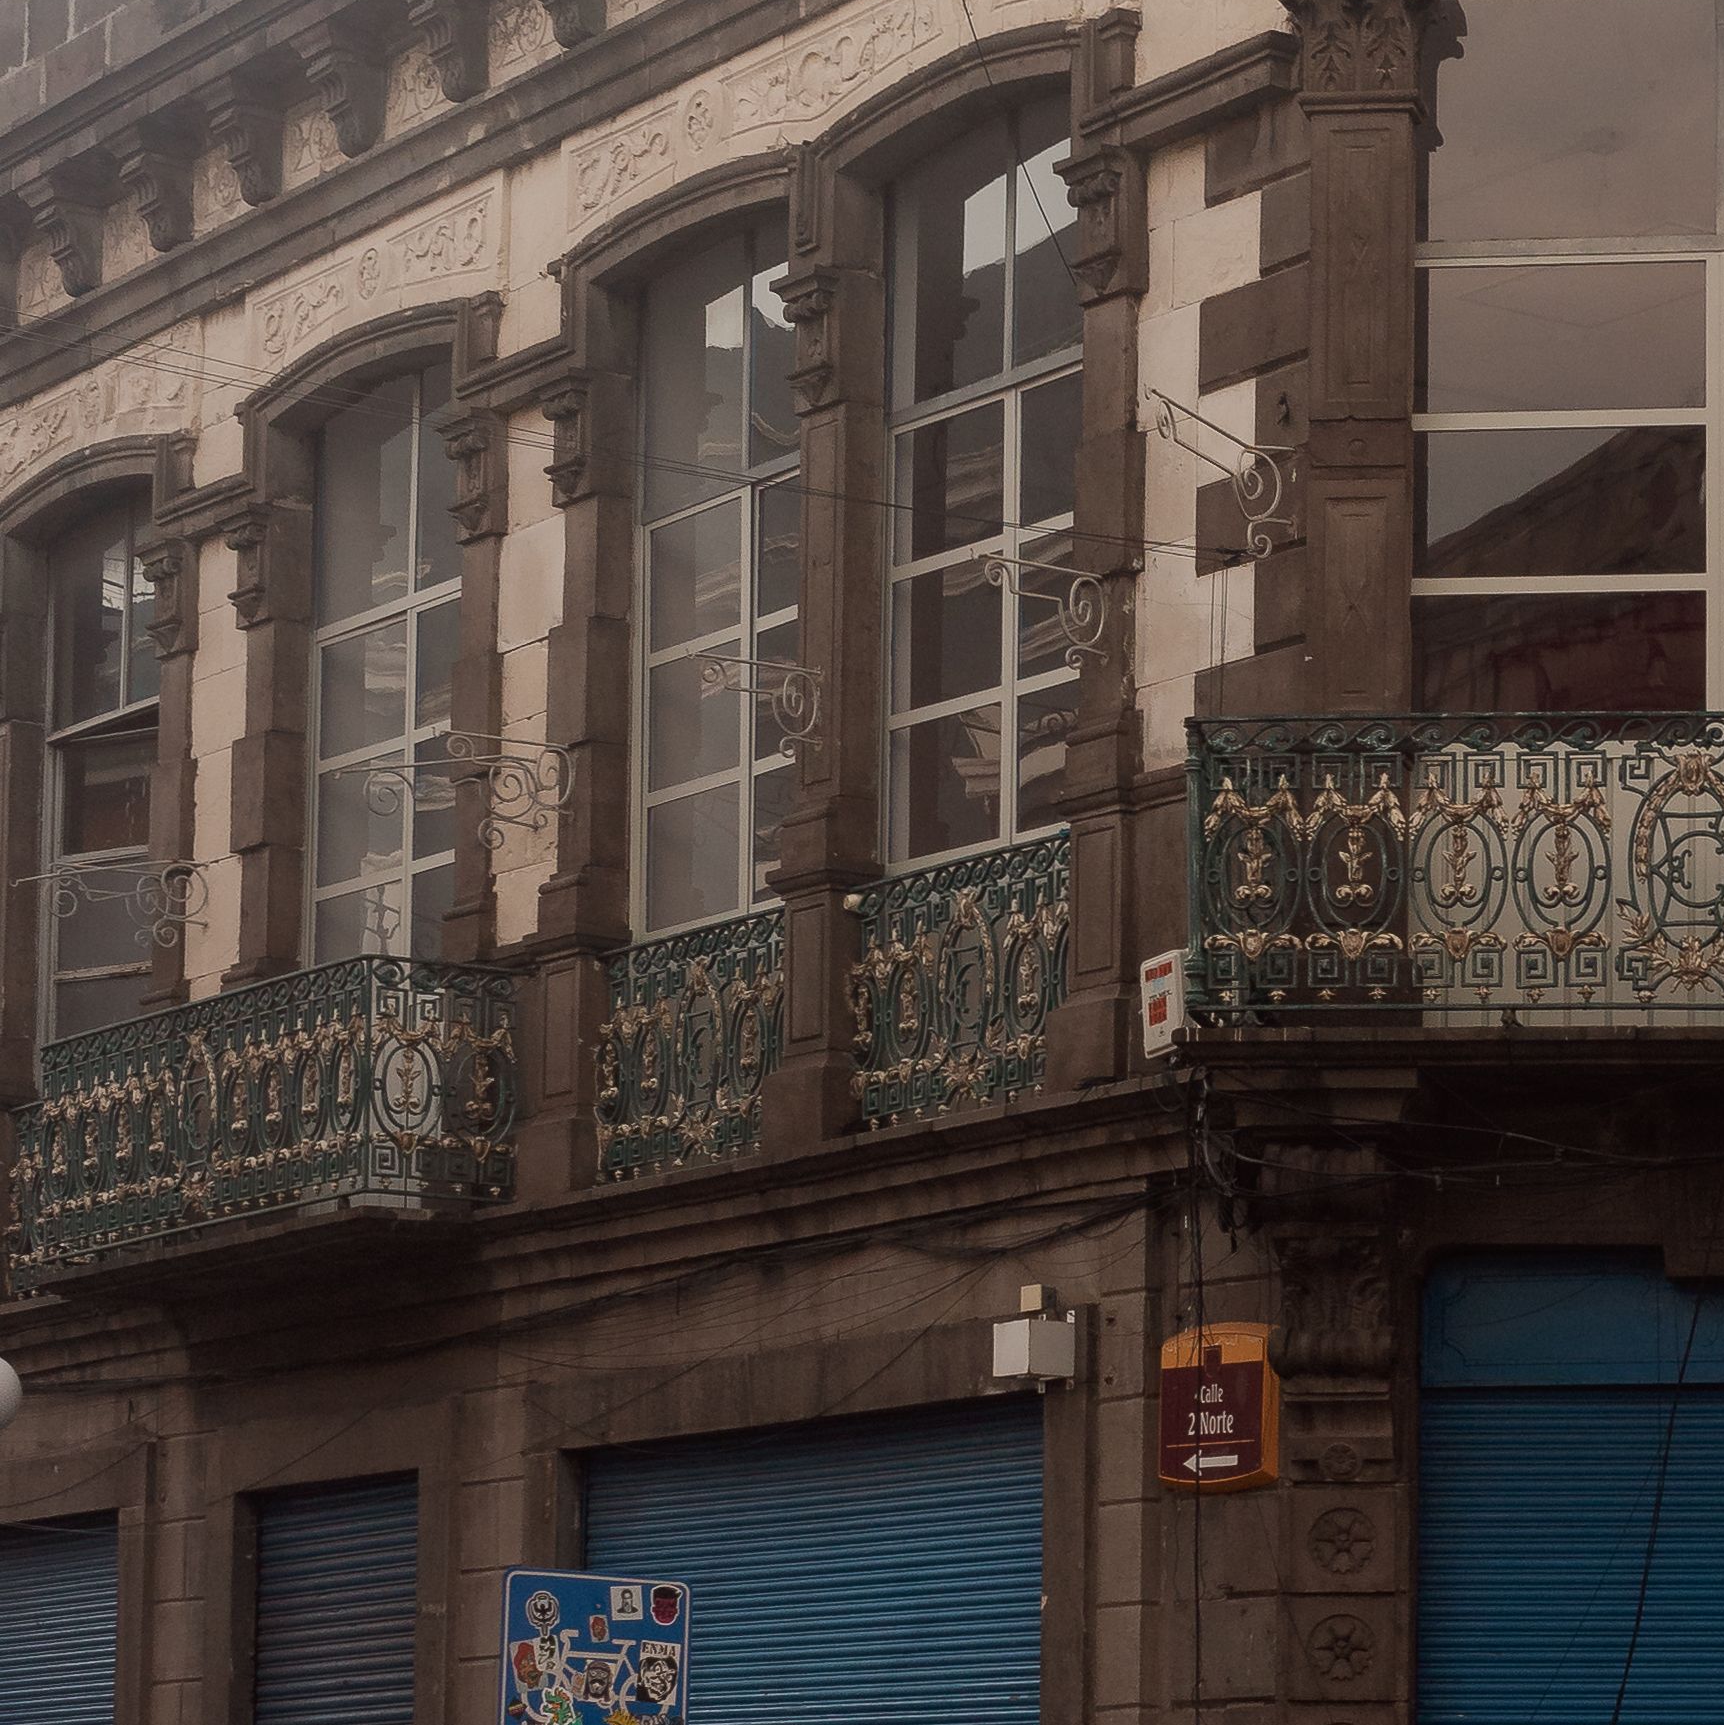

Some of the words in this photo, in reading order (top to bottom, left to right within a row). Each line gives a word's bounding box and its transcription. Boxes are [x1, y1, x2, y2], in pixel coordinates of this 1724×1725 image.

[1200, 1383, 1224, 1404] Calle
[1187, 1411, 1197, 1436] 2
[1200, 1410, 1234, 1436] Norte
